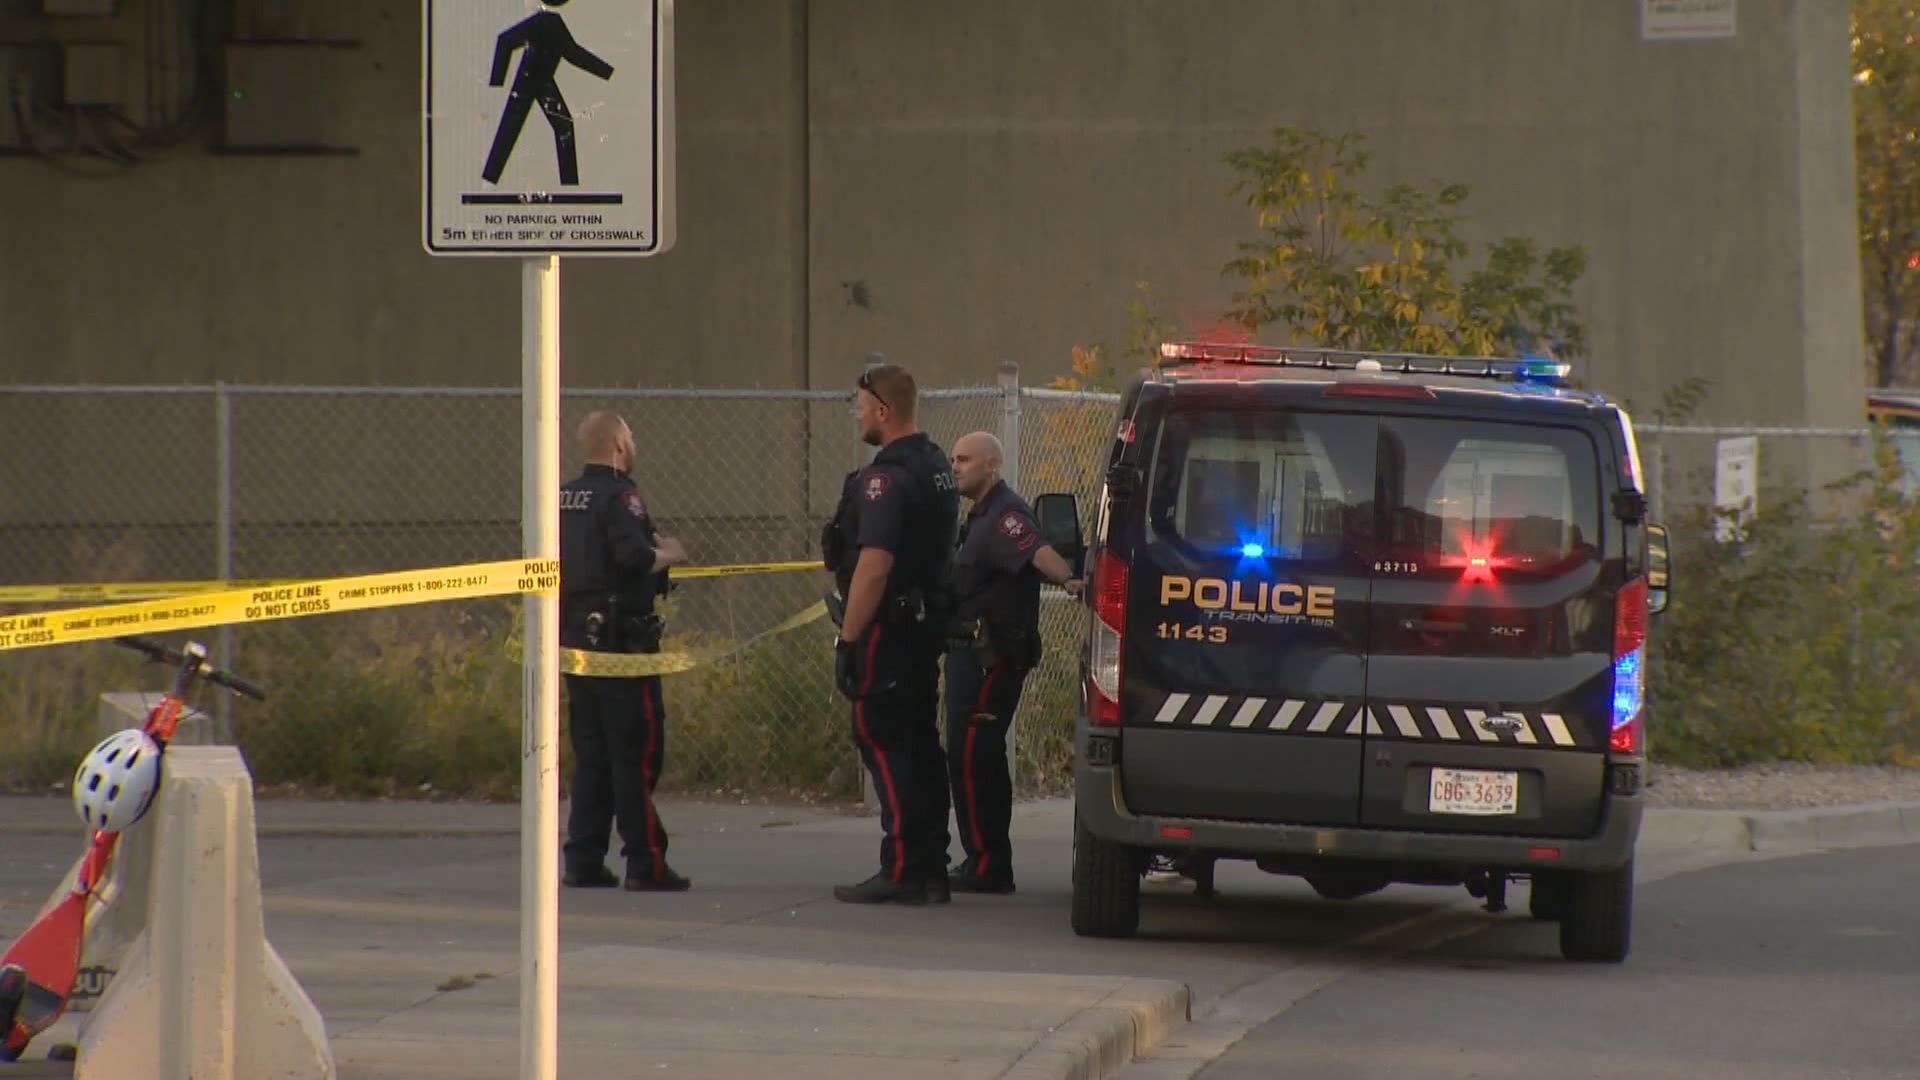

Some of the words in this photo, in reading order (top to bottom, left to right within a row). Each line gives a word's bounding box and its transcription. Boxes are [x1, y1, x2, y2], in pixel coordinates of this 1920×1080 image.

[485, 215, 503, 224] NO
[507, 215, 557, 224] PARKING
[562, 215, 602, 224] WITHIN
[442, 227, 466, 240] 5m
[472, 230, 513, 240] EITHER
[550, 230, 565, 240] OF
[570, 230, 645, 240] CROSSWALK
[559, 490, 593, 509] OLICE
[338, 587, 366, 599] CRIME
[369, 582, 414, 596] STOPPERS
[417, 575, 488, 591] 1-800-222-8477
[518, 577, 534, 590] DO
[537, 575, 558, 588] NOT
[252, 588, 292, 604] POLICE
[296, 585, 322, 598] LINE
[1160, 575, 1336, 617] POLICE
[245, 606, 262, 618] DO
[265, 602, 288, 616] NOT
[291, 599, 330, 614] CROSS
[1204, 609, 1306, 624] TRANSIT
[1158, 621, 1228, 643] 1143
[1490, 626, 1525, 636] XLT
